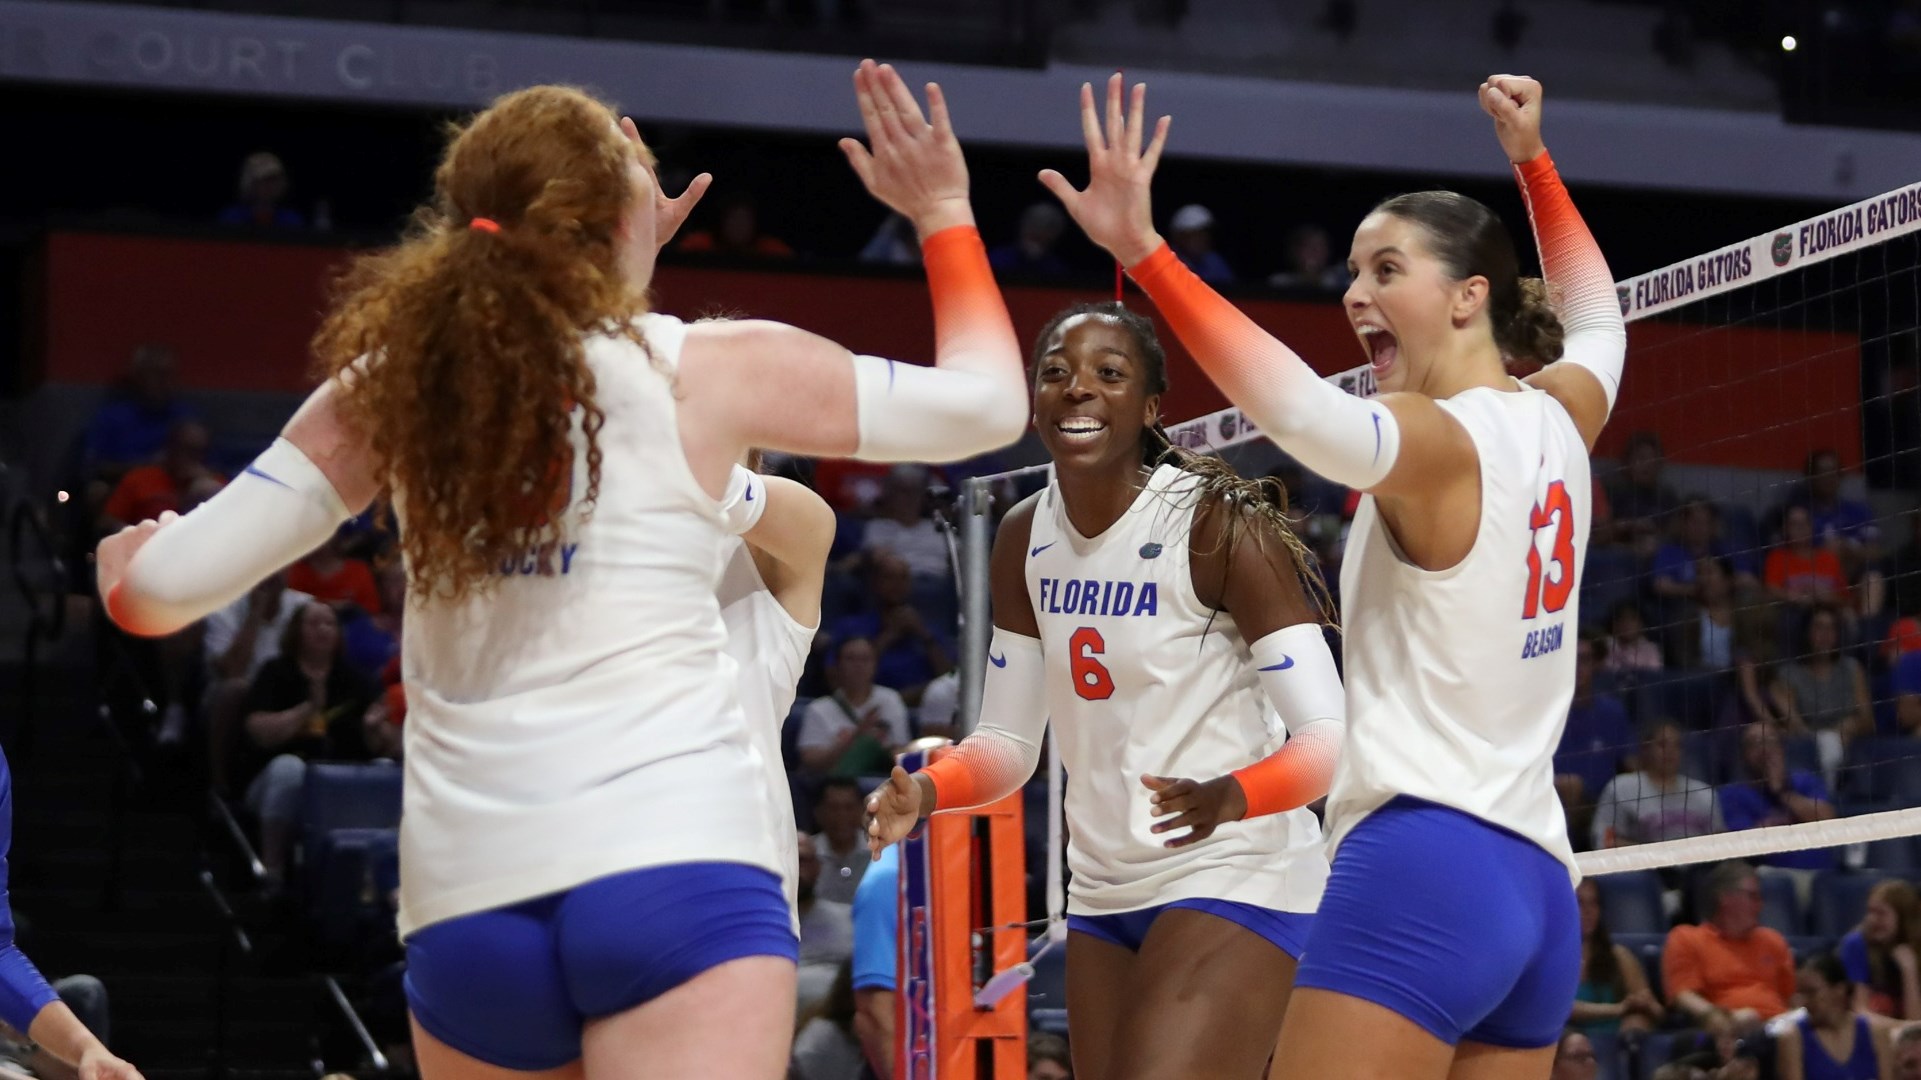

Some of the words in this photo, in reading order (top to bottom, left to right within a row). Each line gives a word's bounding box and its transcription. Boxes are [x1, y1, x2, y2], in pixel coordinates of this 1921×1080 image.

[1799, 207, 1864, 257] FLORIDA
[1636, 268, 1694, 309] FLORIDA
[1697, 247, 1752, 290] GATORS
[1521, 479, 1575, 620] 13
[1040, 578, 1158, 617] FLORIDA
[1069, 626, 1116, 701] 6
[1521, 622, 1564, 659] BEASON
